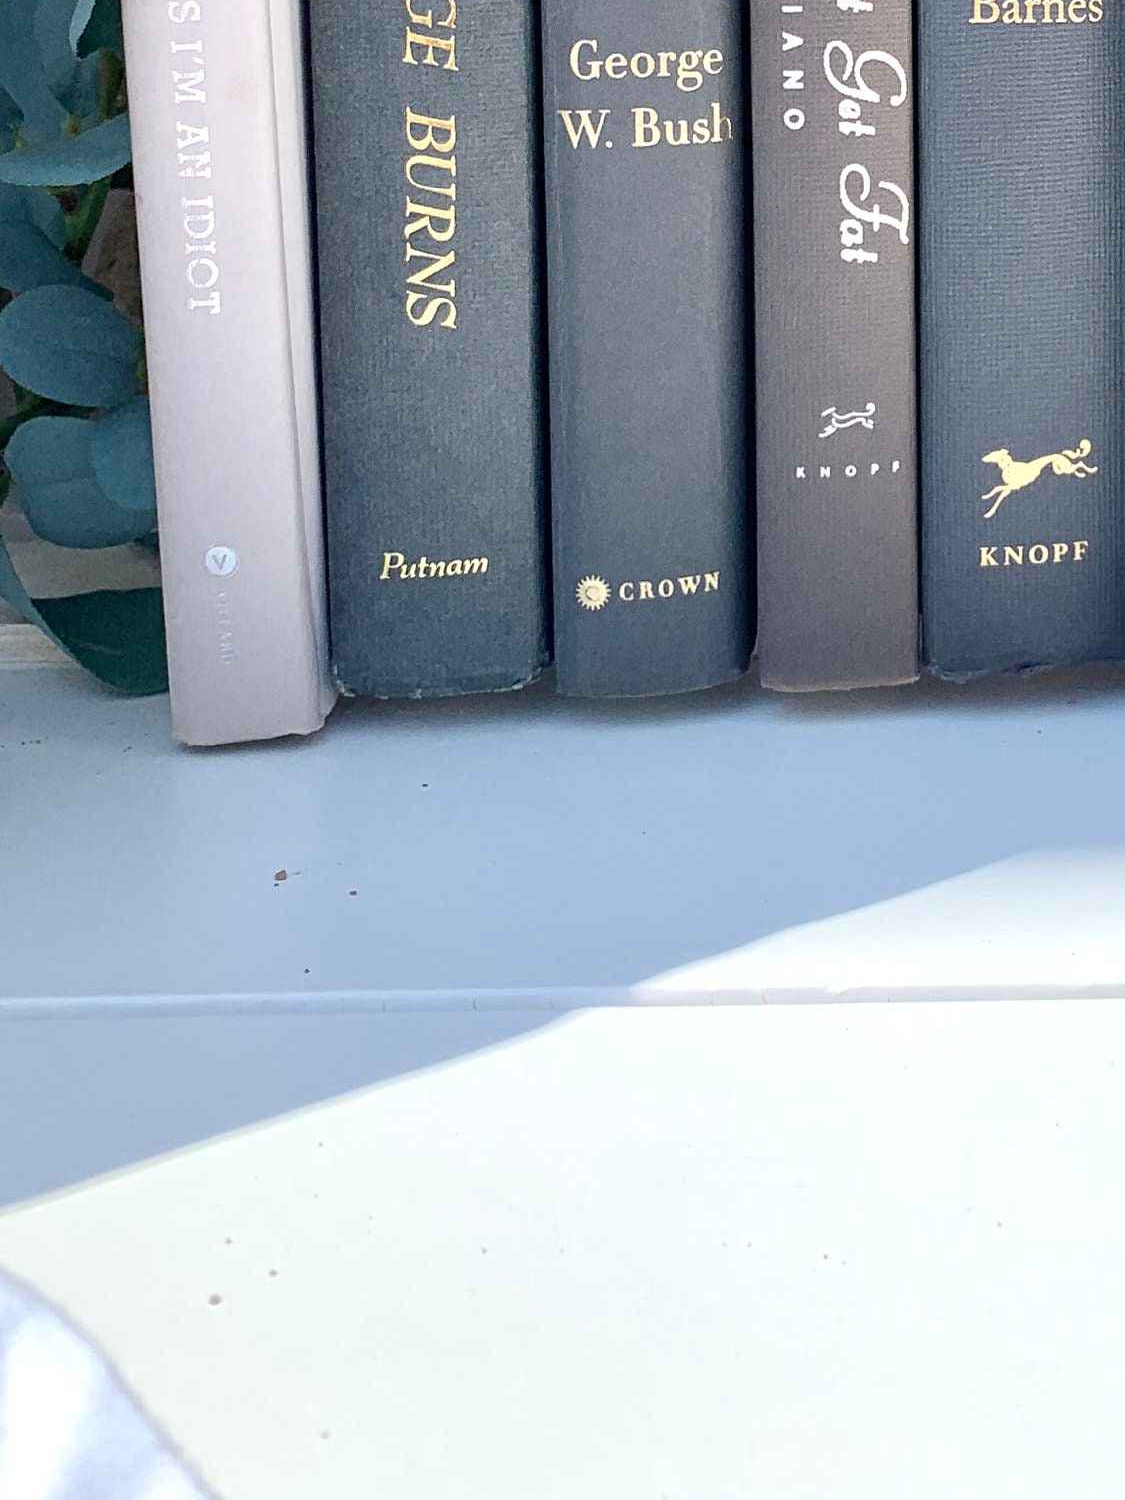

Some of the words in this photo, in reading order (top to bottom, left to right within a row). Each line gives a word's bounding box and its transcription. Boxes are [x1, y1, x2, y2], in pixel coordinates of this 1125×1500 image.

[170, 38, 206, 105] I'M
[569, 39, 724, 91] George
[823, 39, 908, 137] Get
[174, 121, 211, 179] AN
[556, 110, 613, 149] W.
[632, 102, 733, 148] Bush
[404, 106, 457, 330] BURNS
[839, 163, 910, 264] Fat
[181, 191, 222, 317] IDIOT
[796, 460, 900, 478] KNOPF
[379, 552, 489, 580] Putnam
[979, 540, 1089, 567] KNOPF
[619, 572, 720, 601] CROWN
